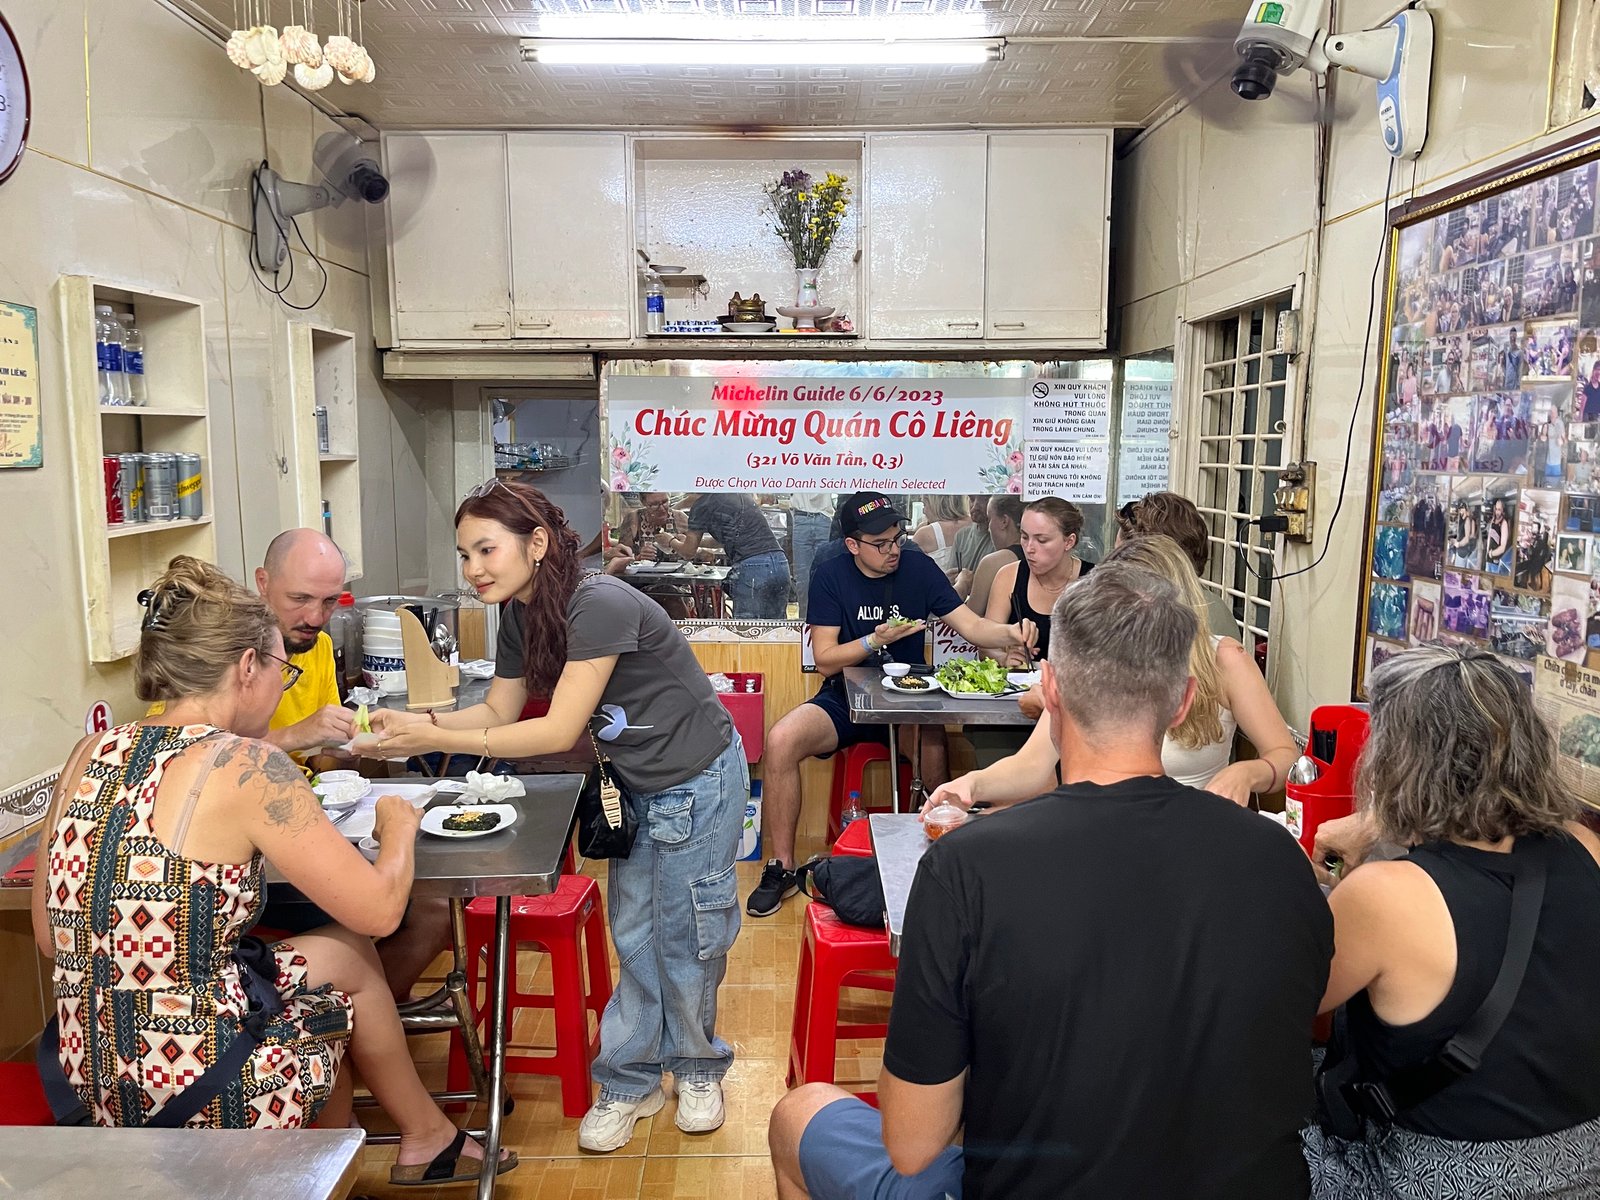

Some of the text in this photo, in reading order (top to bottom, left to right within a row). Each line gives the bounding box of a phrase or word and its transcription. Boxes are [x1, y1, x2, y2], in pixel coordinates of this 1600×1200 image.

[711, 385, 944, 406] Michelin Guide 6/6/2023
[635, 408, 1013, 446] Chúc Mừng Quán Cô Liêng
[747, 451, 904, 470] (321 Võ Văn Tần, Q.3)
[695, 477, 946, 490] Được Chọn Vào Danh Sách Michelin Selected
